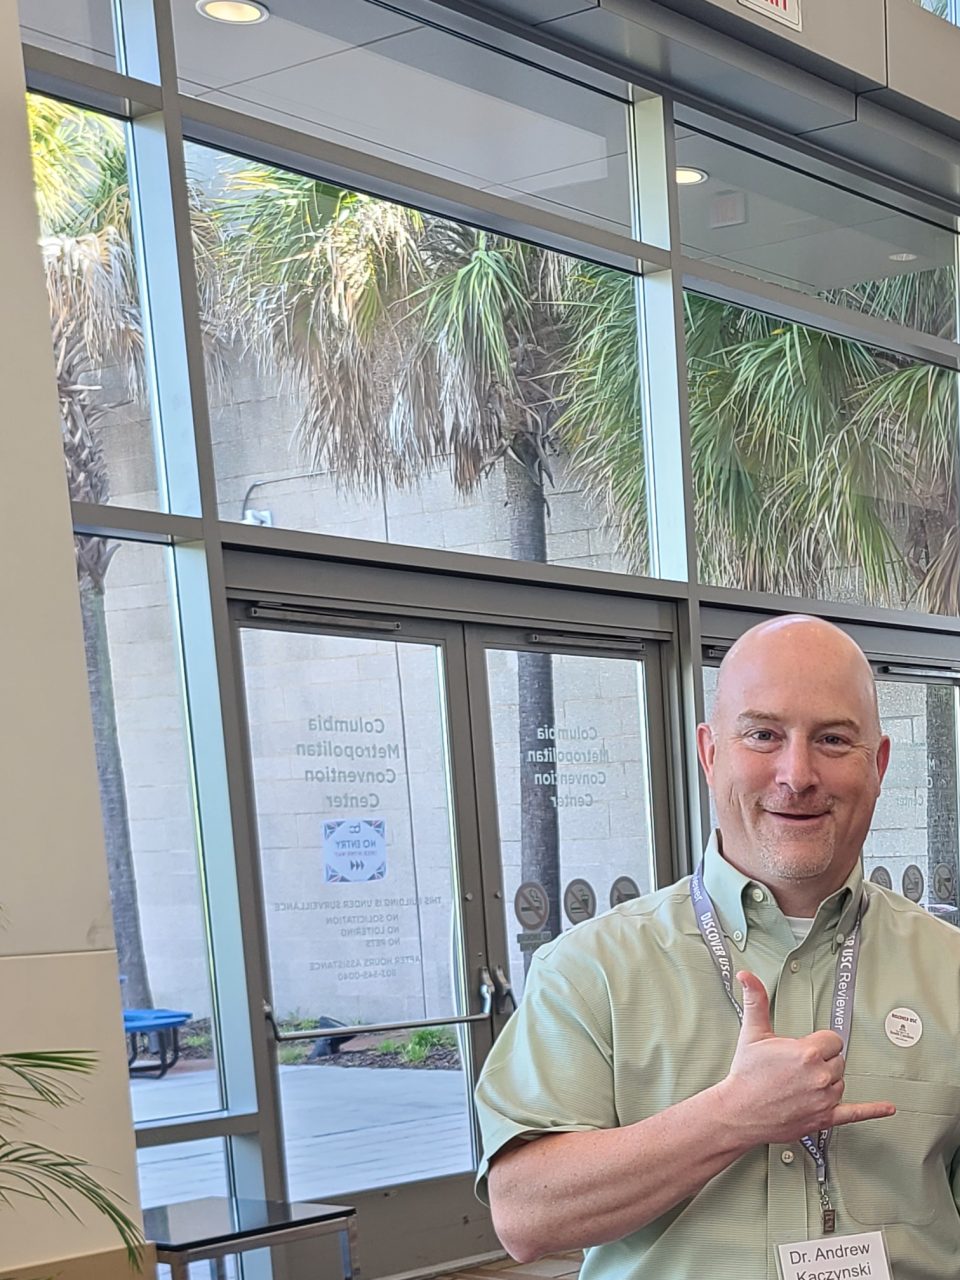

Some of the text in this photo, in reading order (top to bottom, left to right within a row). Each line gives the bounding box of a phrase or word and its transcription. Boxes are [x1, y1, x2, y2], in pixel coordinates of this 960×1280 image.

[701, 911, 731, 979] DISCOVER USC
[840, 949, 854, 969] USC
[834, 972, 851, 1030] Reviewer
[789, 1244, 870, 1265] Dr. Andrew
